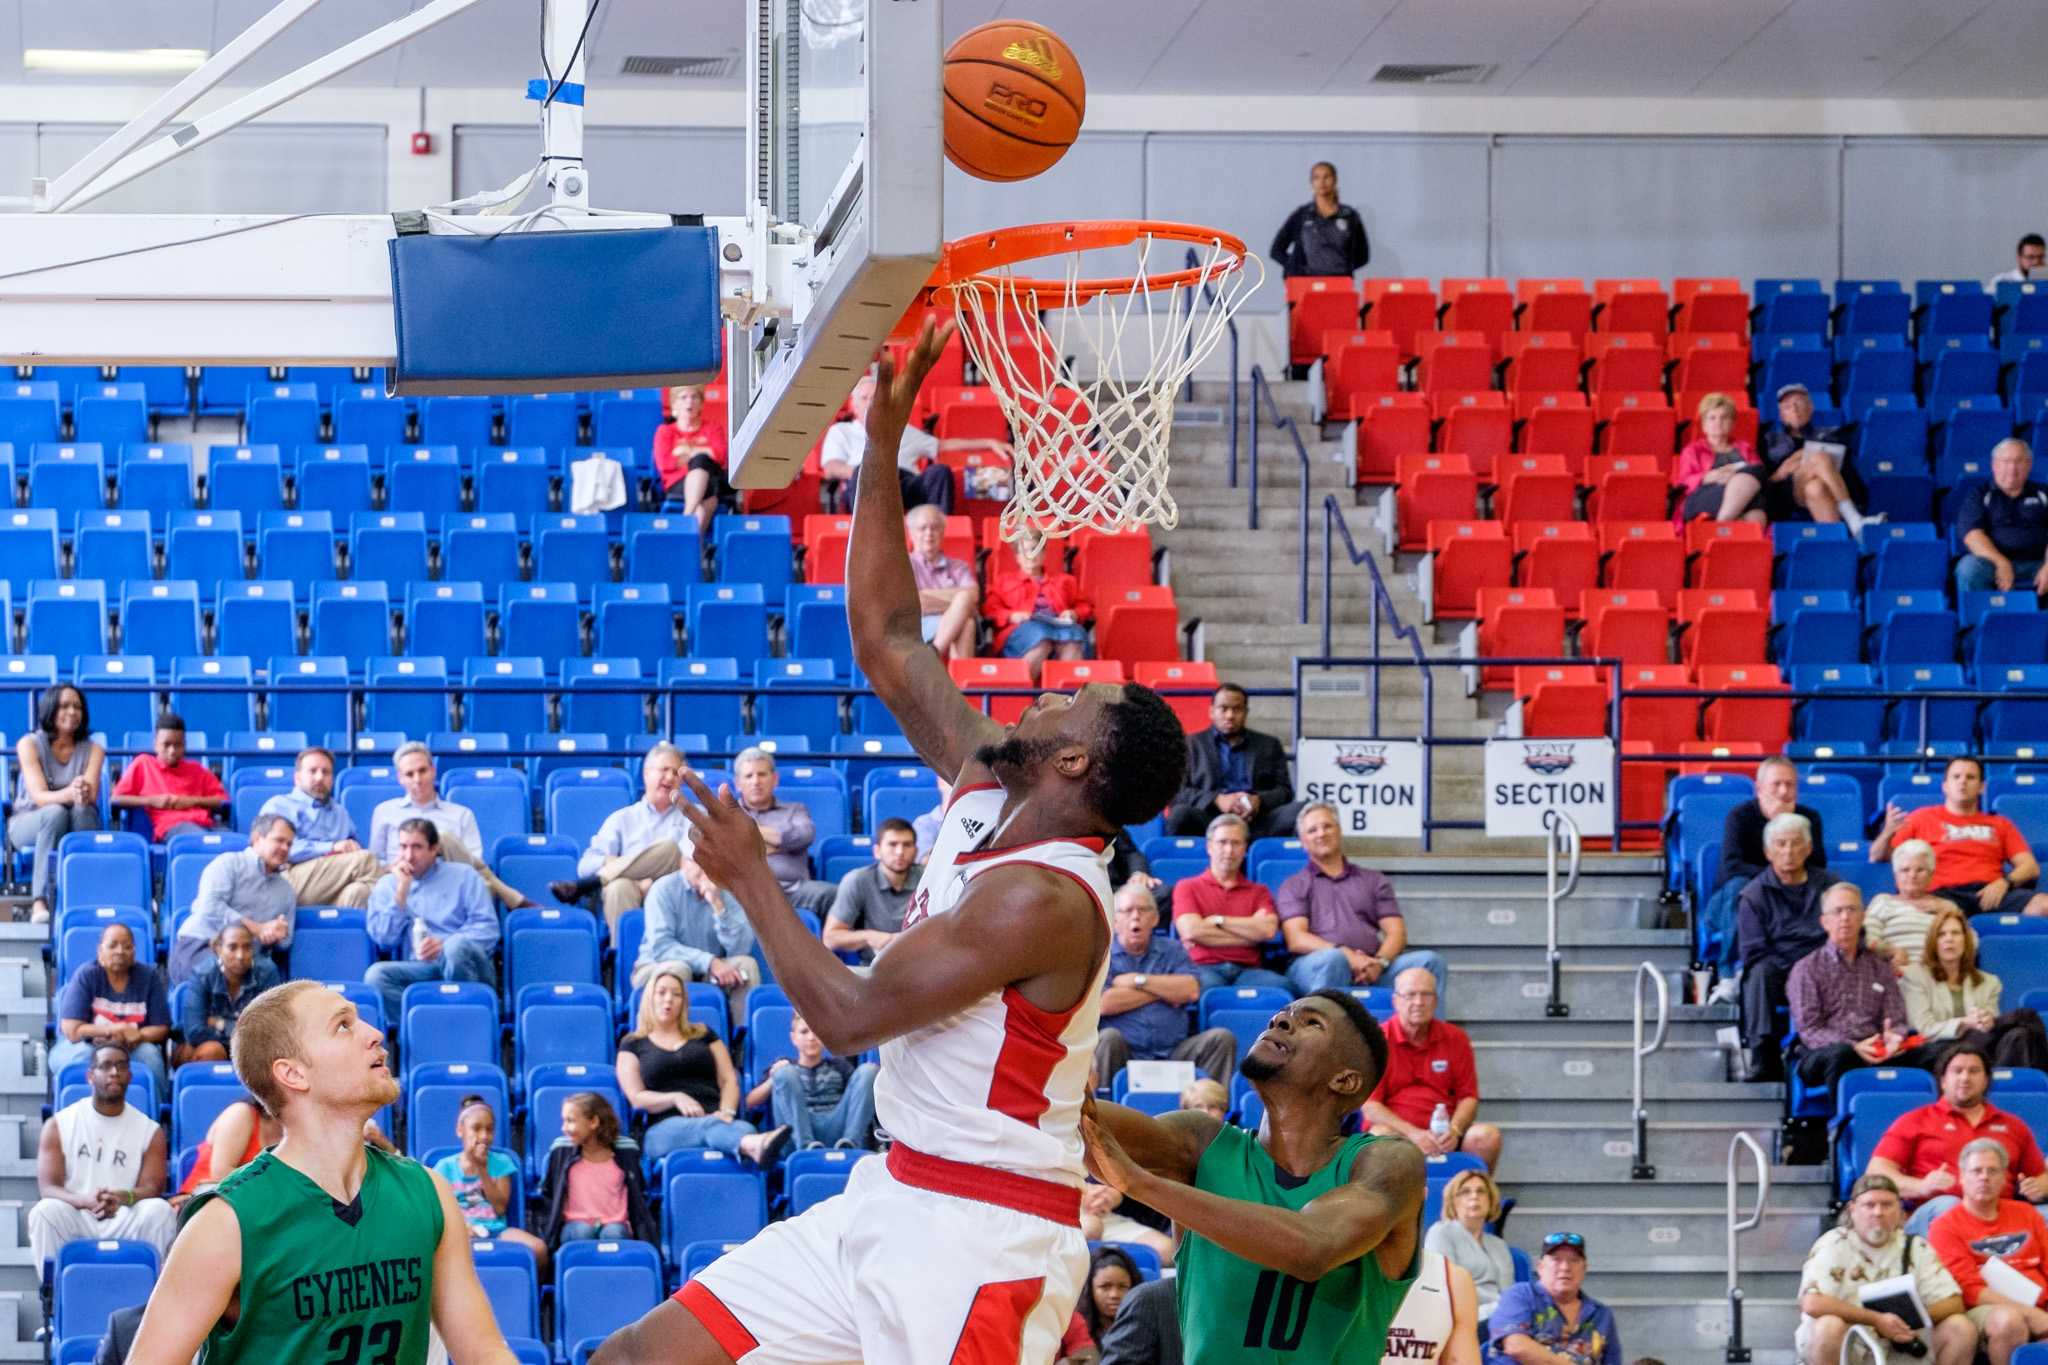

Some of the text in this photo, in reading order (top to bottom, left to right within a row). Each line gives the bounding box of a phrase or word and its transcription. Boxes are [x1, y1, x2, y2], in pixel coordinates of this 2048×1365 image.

[988, 83, 1048, 118] PRO
[1306, 783, 1415, 806] SECTION
[1495, 783, 1605, 805] SECTION
[1352, 810, 1367, 831] B
[292, 1257, 422, 1321] GYRENES
[1242, 1269, 1319, 1352] 10
[324, 1319, 402, 1365] 23
